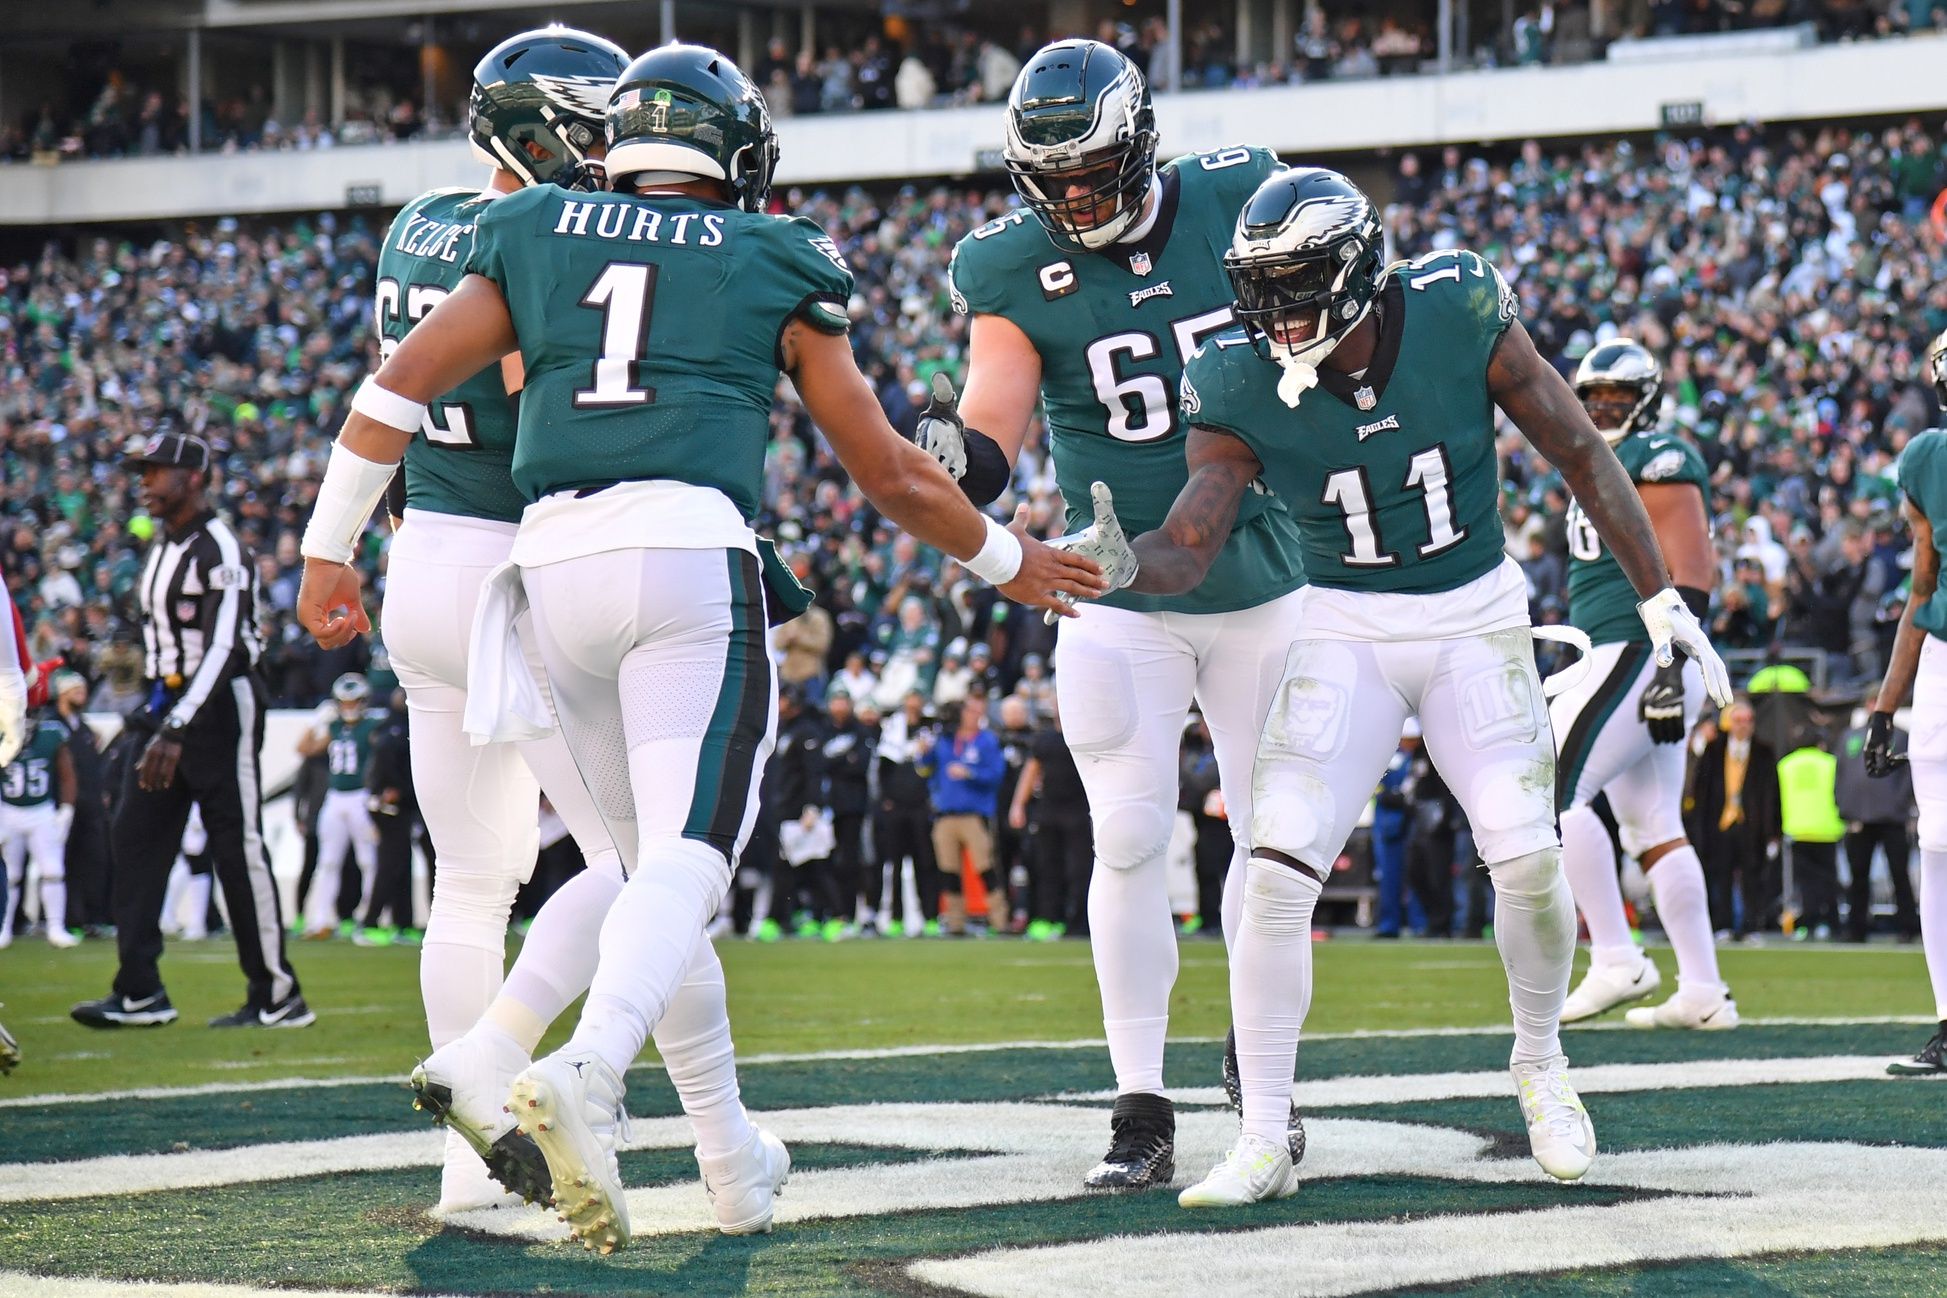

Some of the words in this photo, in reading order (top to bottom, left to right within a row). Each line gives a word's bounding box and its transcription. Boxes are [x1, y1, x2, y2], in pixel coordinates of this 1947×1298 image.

[396, 212, 473, 263] KELCE
[553, 200, 727, 247] HURTS
[1039, 261, 1074, 292] C
[1128, 280, 1174, 307] EAGLES
[571, 259, 660, 409] 1
[1355, 414, 1400, 441] EAGLES
[1320, 442, 1469, 567] 11
[2, 758, 50, 798] 35
